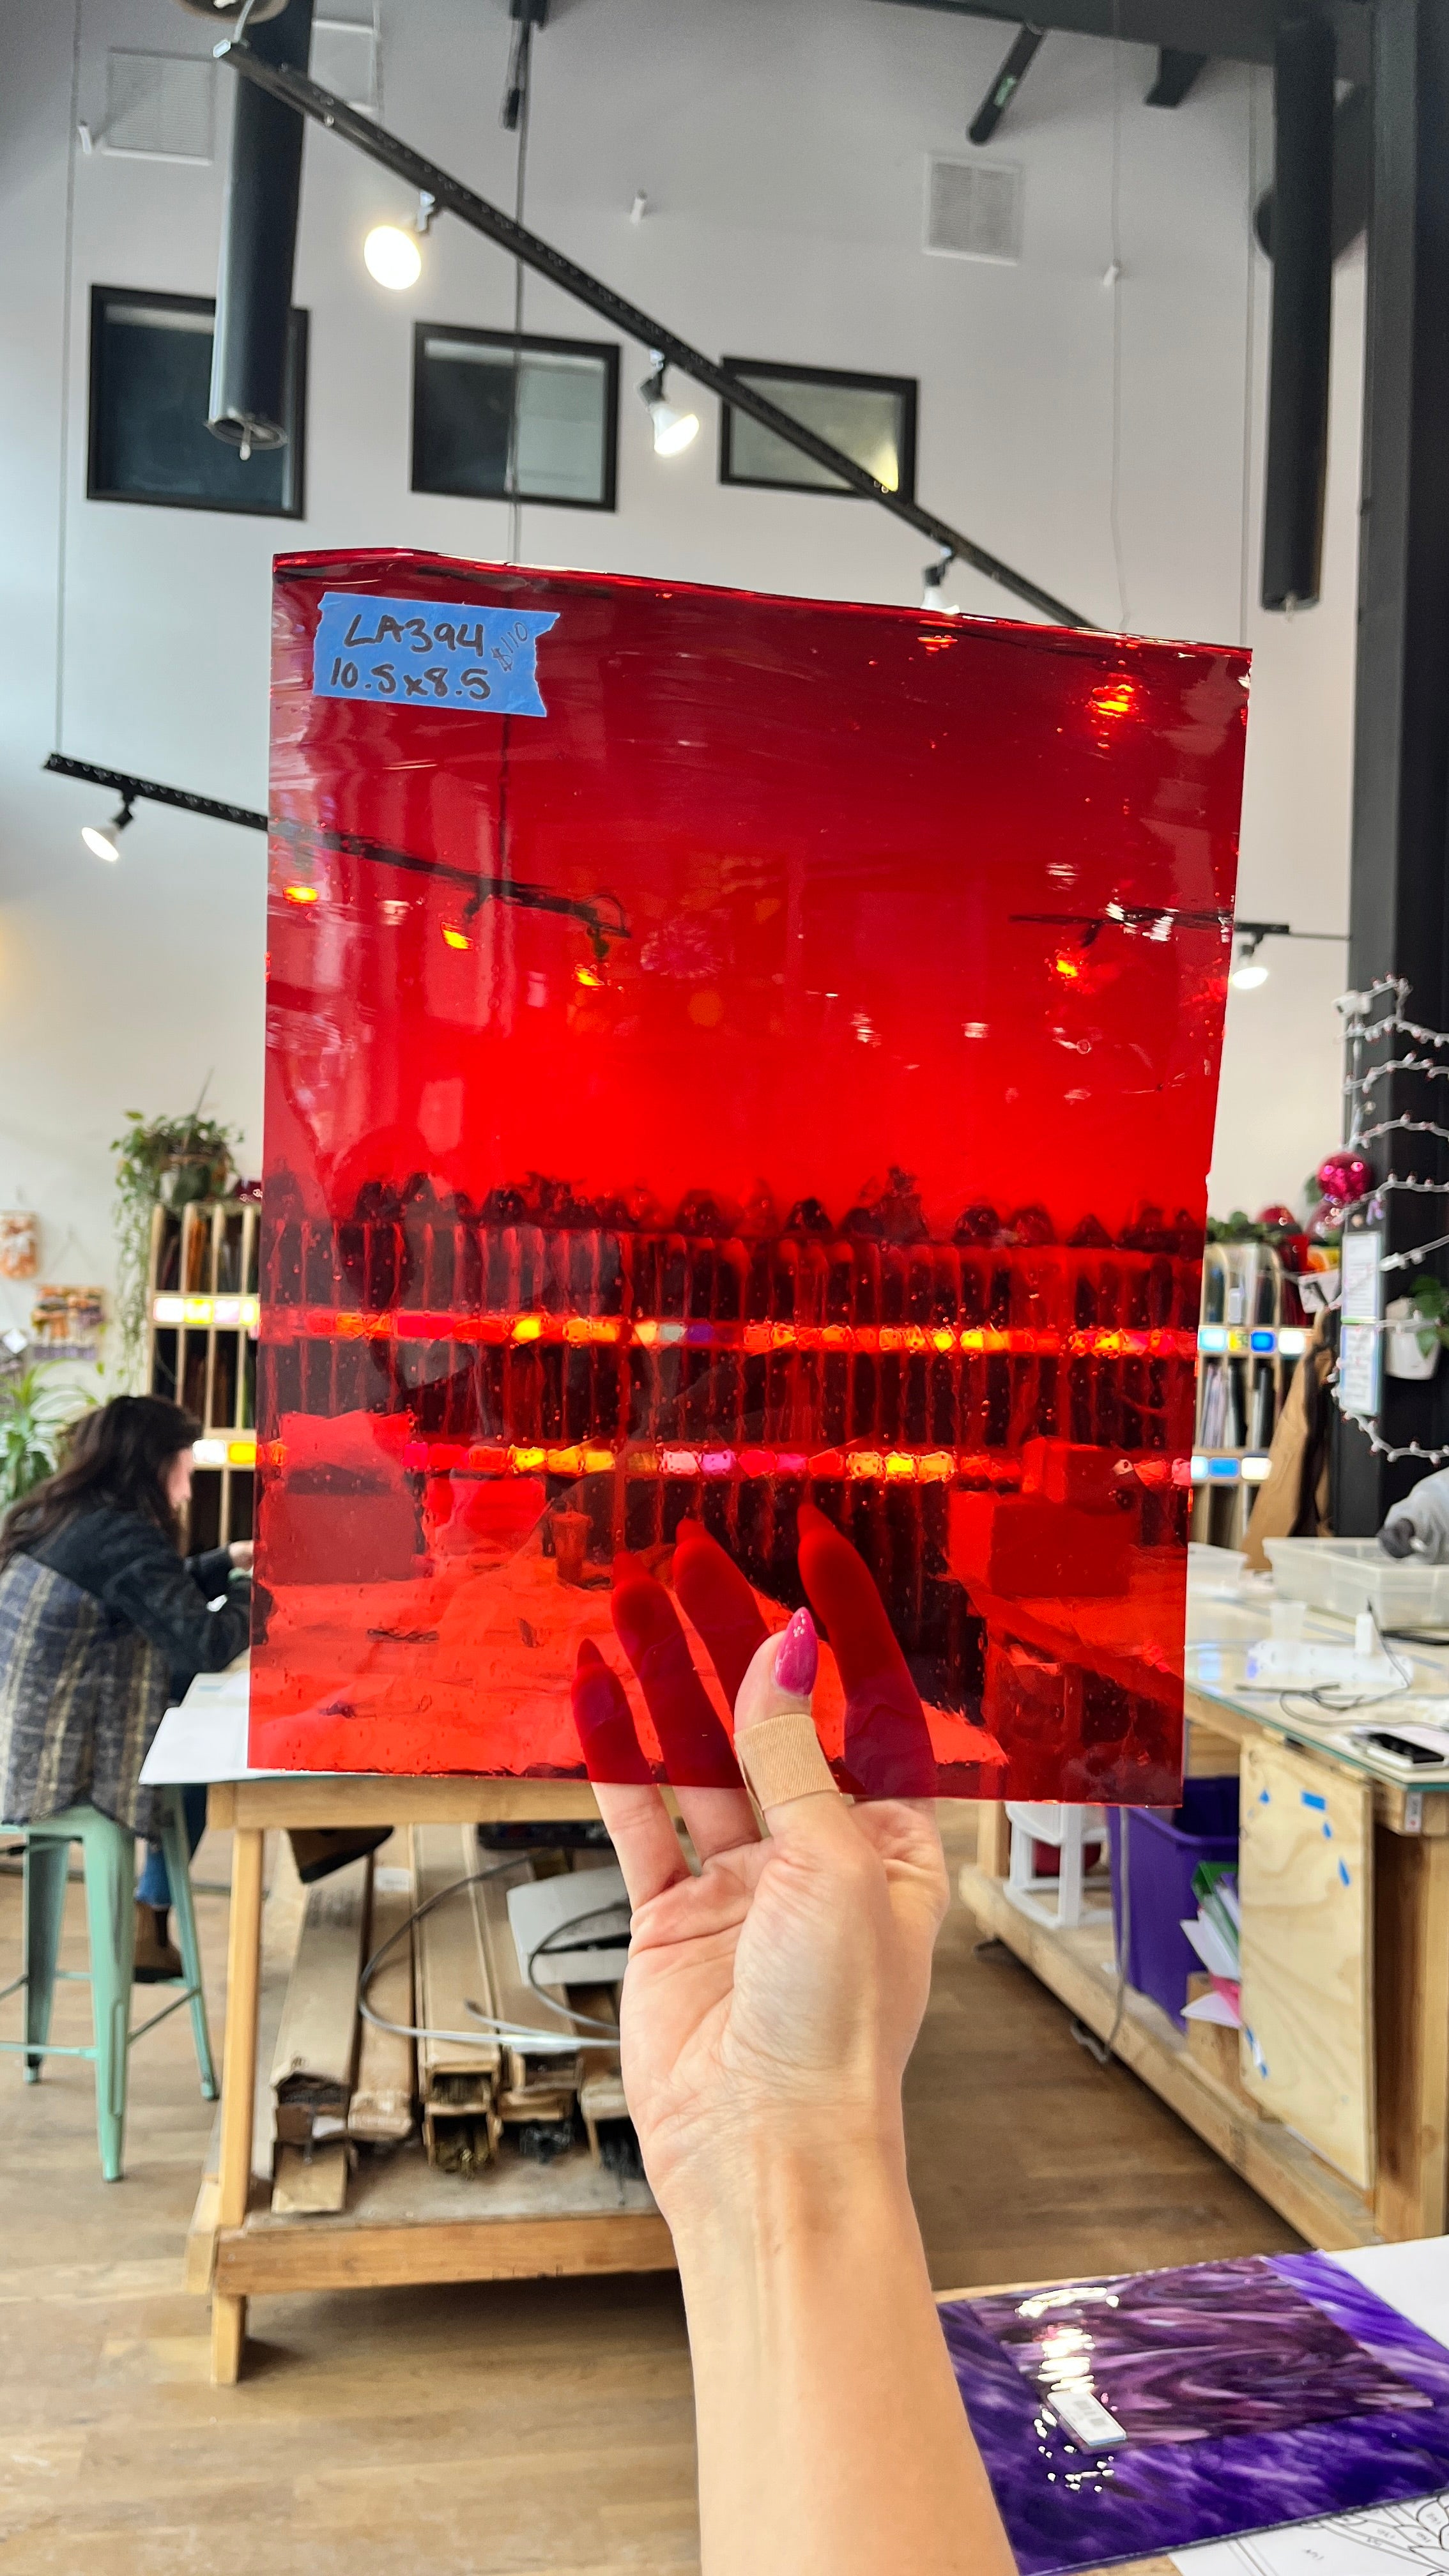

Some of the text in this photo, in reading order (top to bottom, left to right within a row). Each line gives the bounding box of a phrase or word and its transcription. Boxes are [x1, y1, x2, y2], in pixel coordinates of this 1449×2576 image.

[343, 614, 484, 657] LA394
[490, 622, 528, 671] $110
[330, 657, 491, 700] 10.5x8.5
